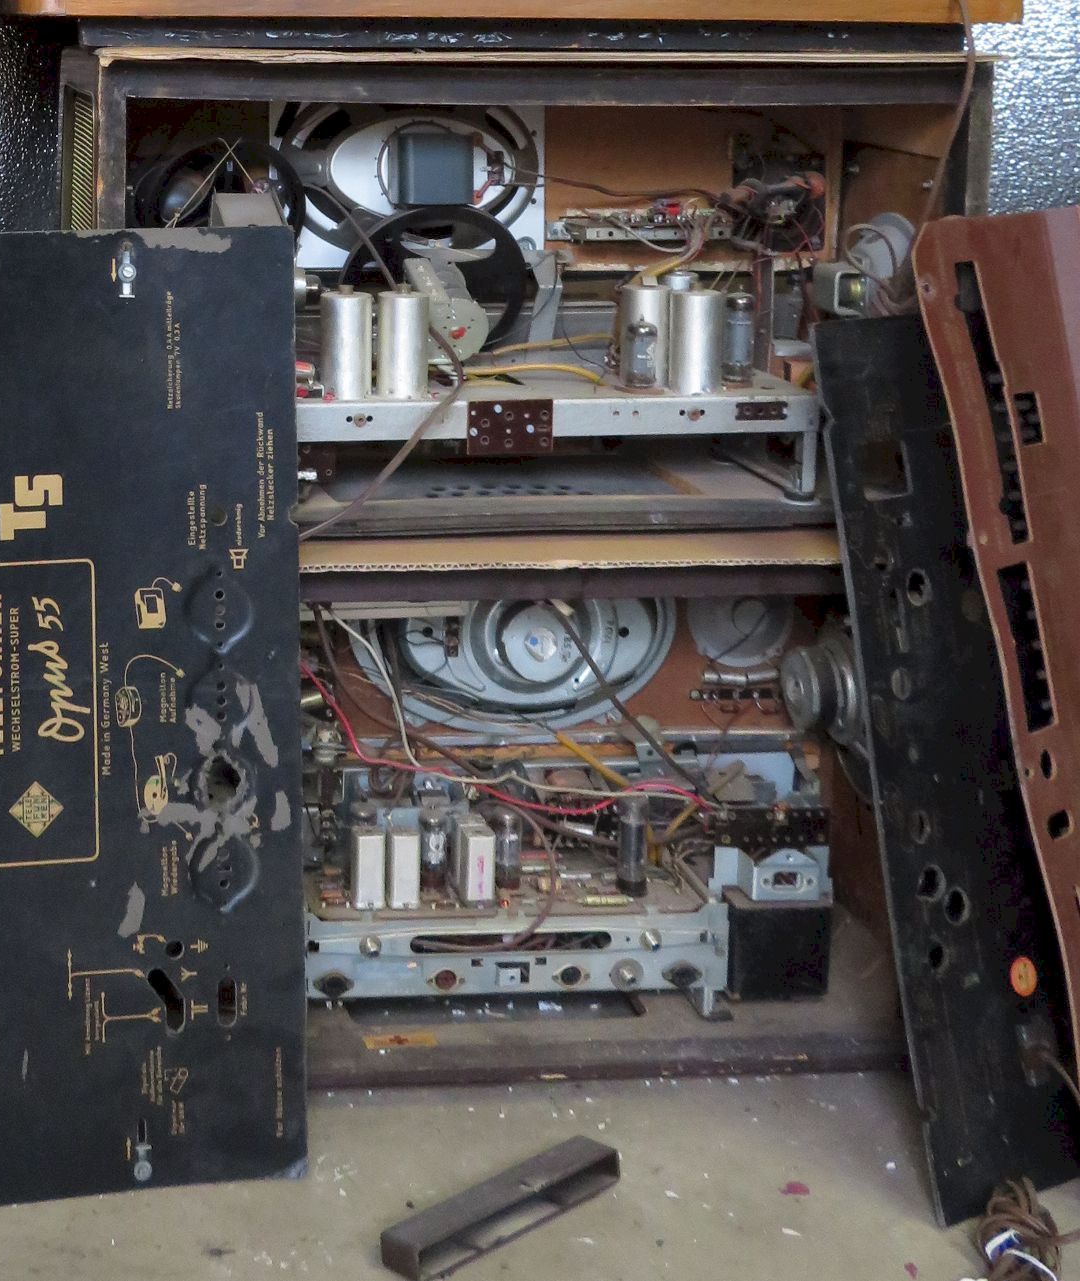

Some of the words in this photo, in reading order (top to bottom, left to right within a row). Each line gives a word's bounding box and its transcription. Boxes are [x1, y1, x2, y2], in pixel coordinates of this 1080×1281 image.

[255, 411, 265, 458] Rückwand
[265, 428, 274, 460] ziehen
[256, 461, 266, 476] der
[265, 463, 275, 521] Netzstecker
[0, 474, 63, 541] TS
[187, 491, 197, 545] Eingestellte
[197, 484, 207, 550] Netzspannung
[256, 479, 266, 522] Abnehmen
[31, 596, 64, 632] 55
[9, 607, 21, 752] WECHSELSTROM-SUPER
[100, 642, 110, 673] West
[27, 640, 91, 743] Opus
[101, 678, 114, 728] Germany
[101, 732, 111, 742] in
[101, 745, 112, 776] Made
